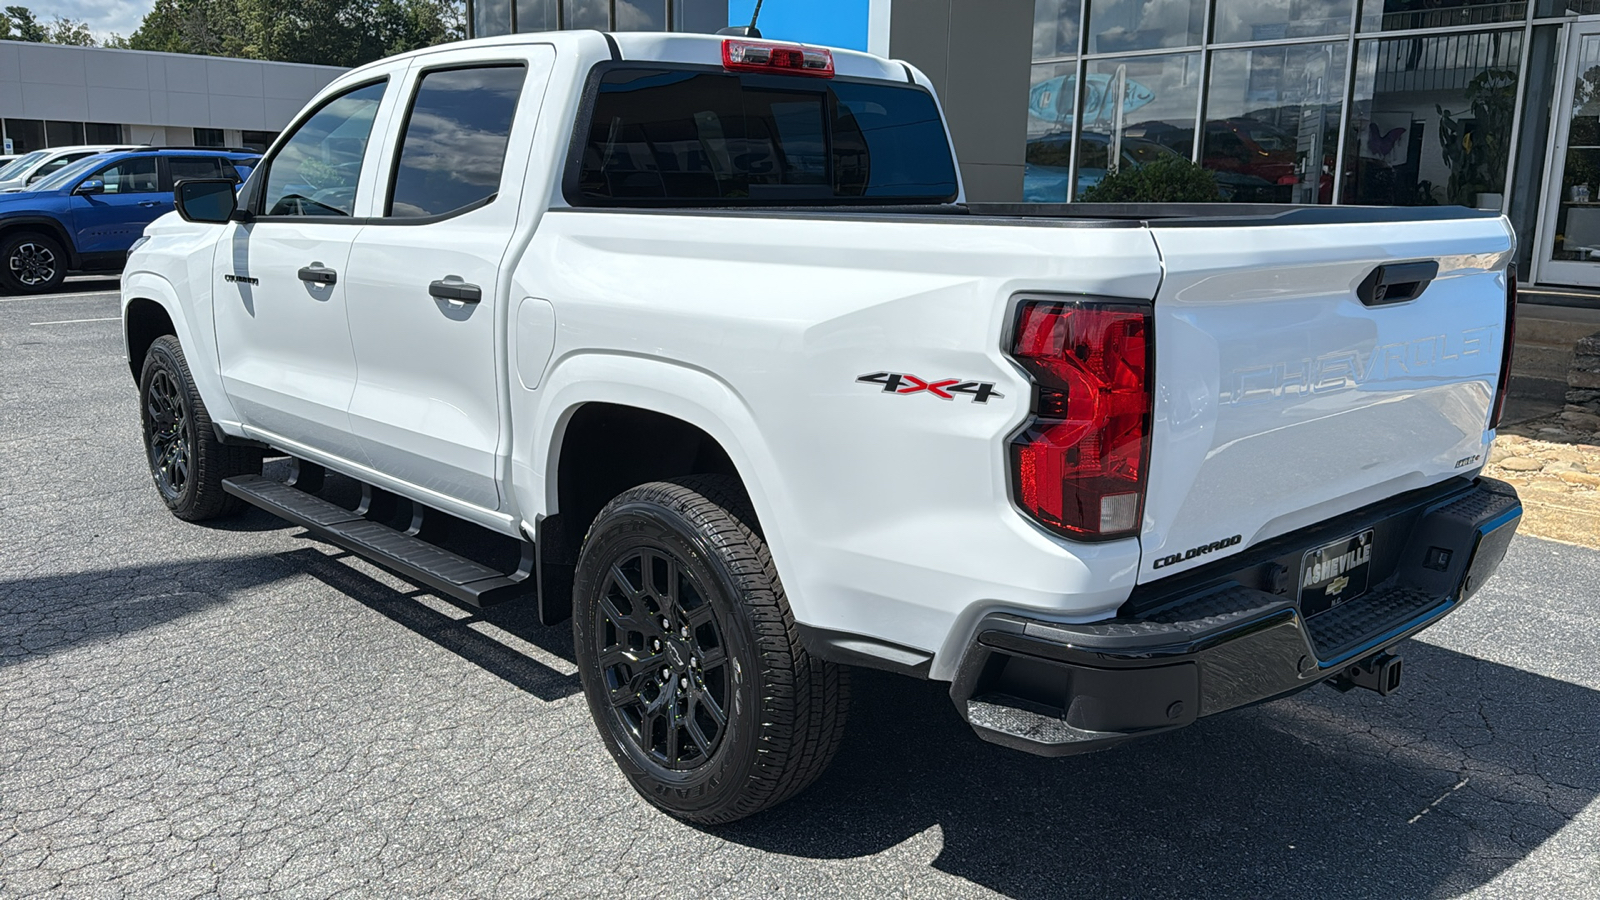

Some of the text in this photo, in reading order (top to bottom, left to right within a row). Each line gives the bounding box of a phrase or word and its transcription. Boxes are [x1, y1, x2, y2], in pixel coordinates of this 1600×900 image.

[1231, 324, 1499, 407] CHEVROLET
[1153, 534, 1242, 569] COLORADO
[1303, 543, 1371, 588] ASHEVILLE
